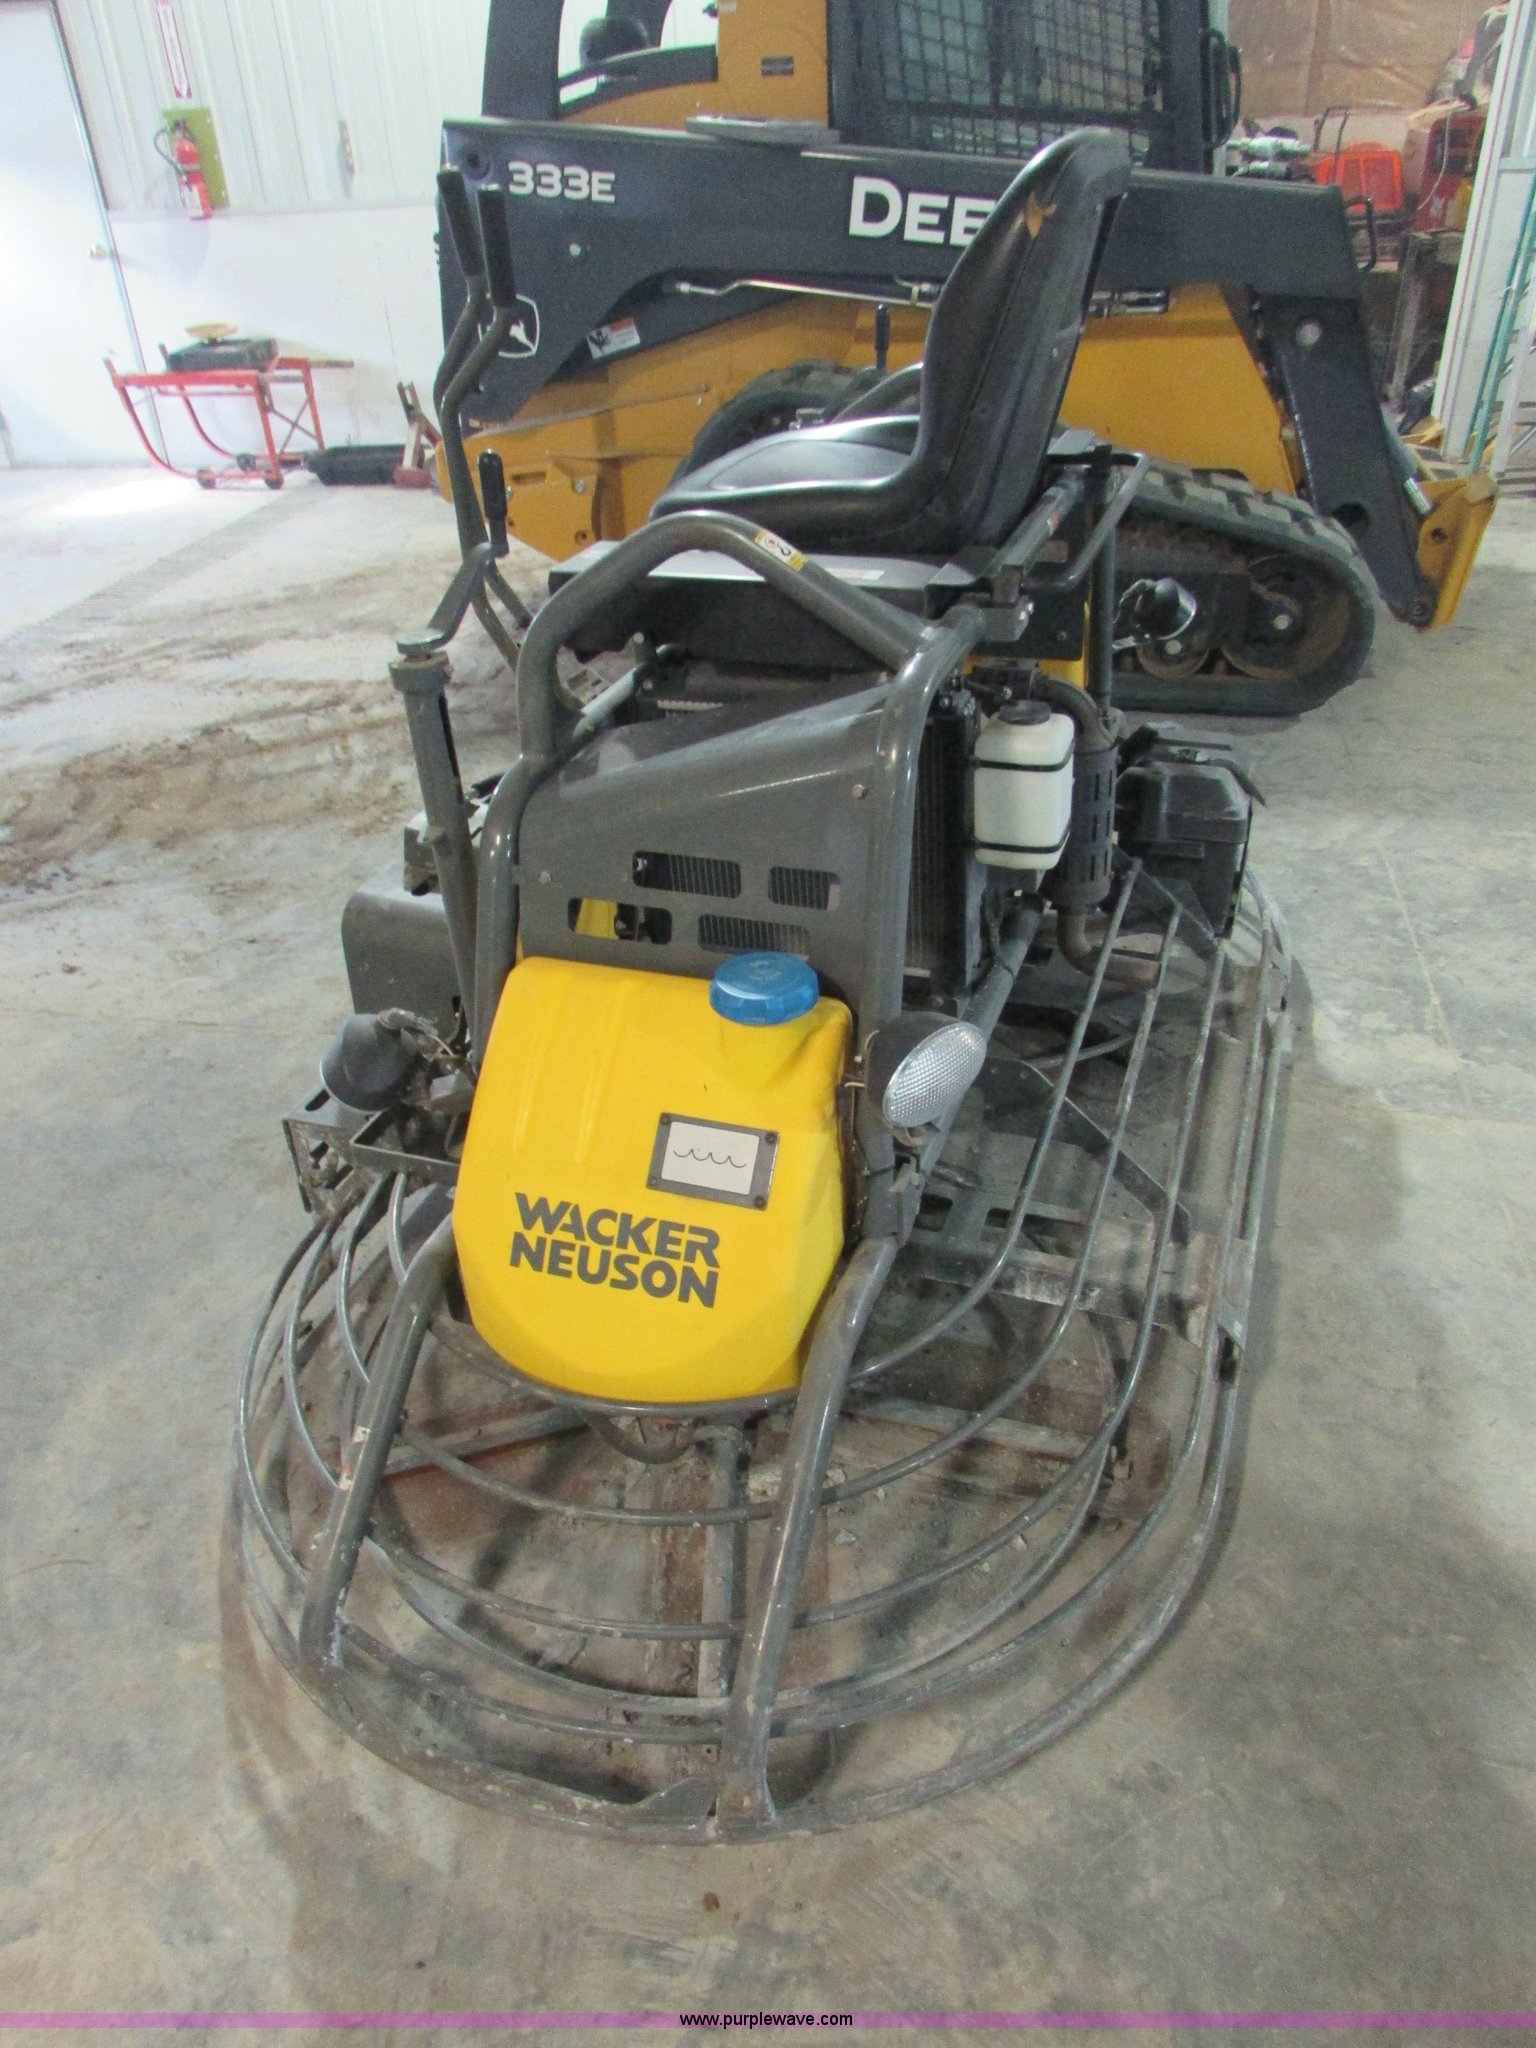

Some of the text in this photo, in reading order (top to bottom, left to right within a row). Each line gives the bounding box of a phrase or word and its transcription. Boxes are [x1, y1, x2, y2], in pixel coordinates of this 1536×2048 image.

[508, 161, 616, 204] 333E
[515, 1192, 720, 1268] WACKER
[509, 1231, 719, 1308] NEUSON
